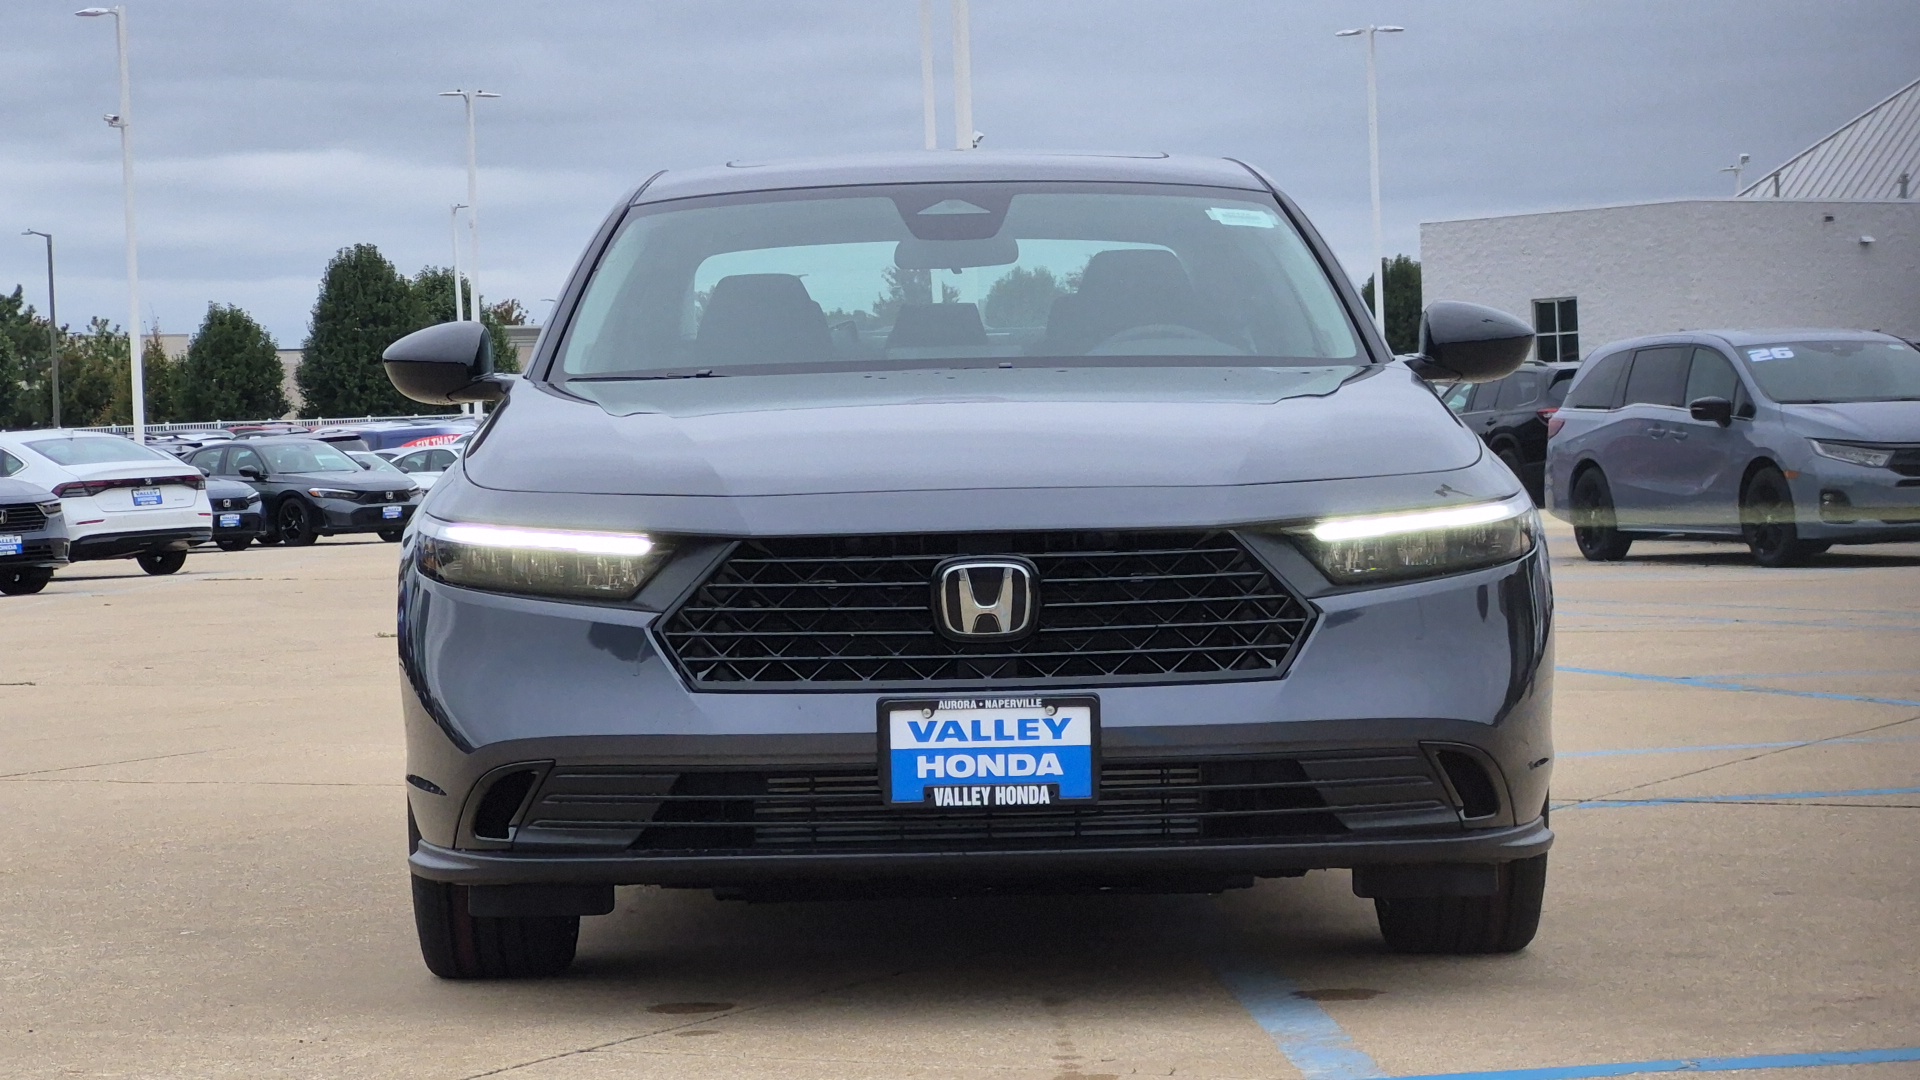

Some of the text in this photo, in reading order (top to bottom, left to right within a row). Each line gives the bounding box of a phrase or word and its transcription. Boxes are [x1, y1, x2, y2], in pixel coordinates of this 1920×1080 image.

[1747, 347, 1794, 362] 26
[938, 698, 1042, 710] AURORA NAPERVILLE
[907, 718, 1072, 743] VALLEY
[917, 753, 1064, 779] HONDA
[934, 785, 1050, 807] VALLEY HONDA
